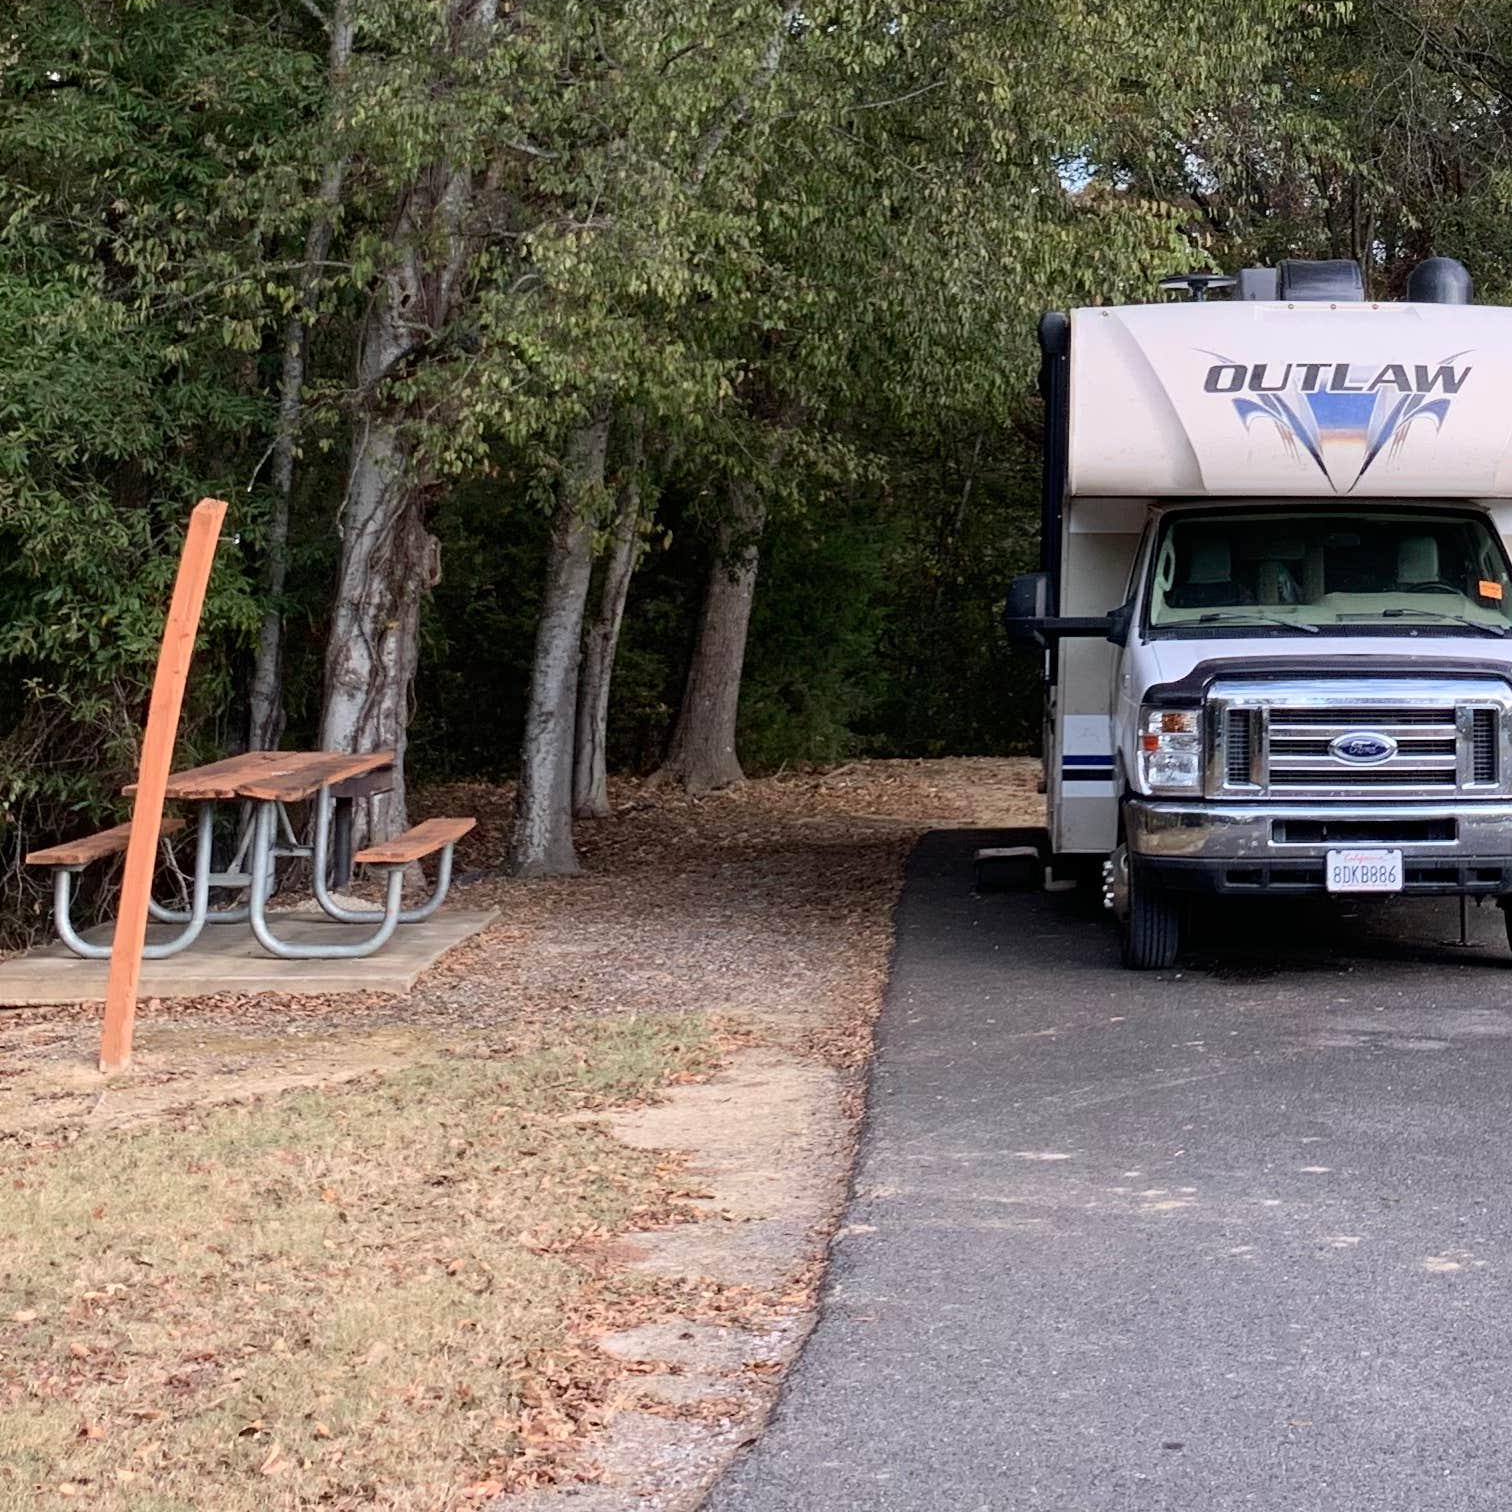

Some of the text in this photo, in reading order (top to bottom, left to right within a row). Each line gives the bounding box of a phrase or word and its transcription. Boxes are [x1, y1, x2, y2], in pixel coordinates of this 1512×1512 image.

[1203, 363, 1472, 394] OUTLAW
[1349, 740, 1378, 753] Ford
[1333, 865, 1396, 883] 8DKB886
